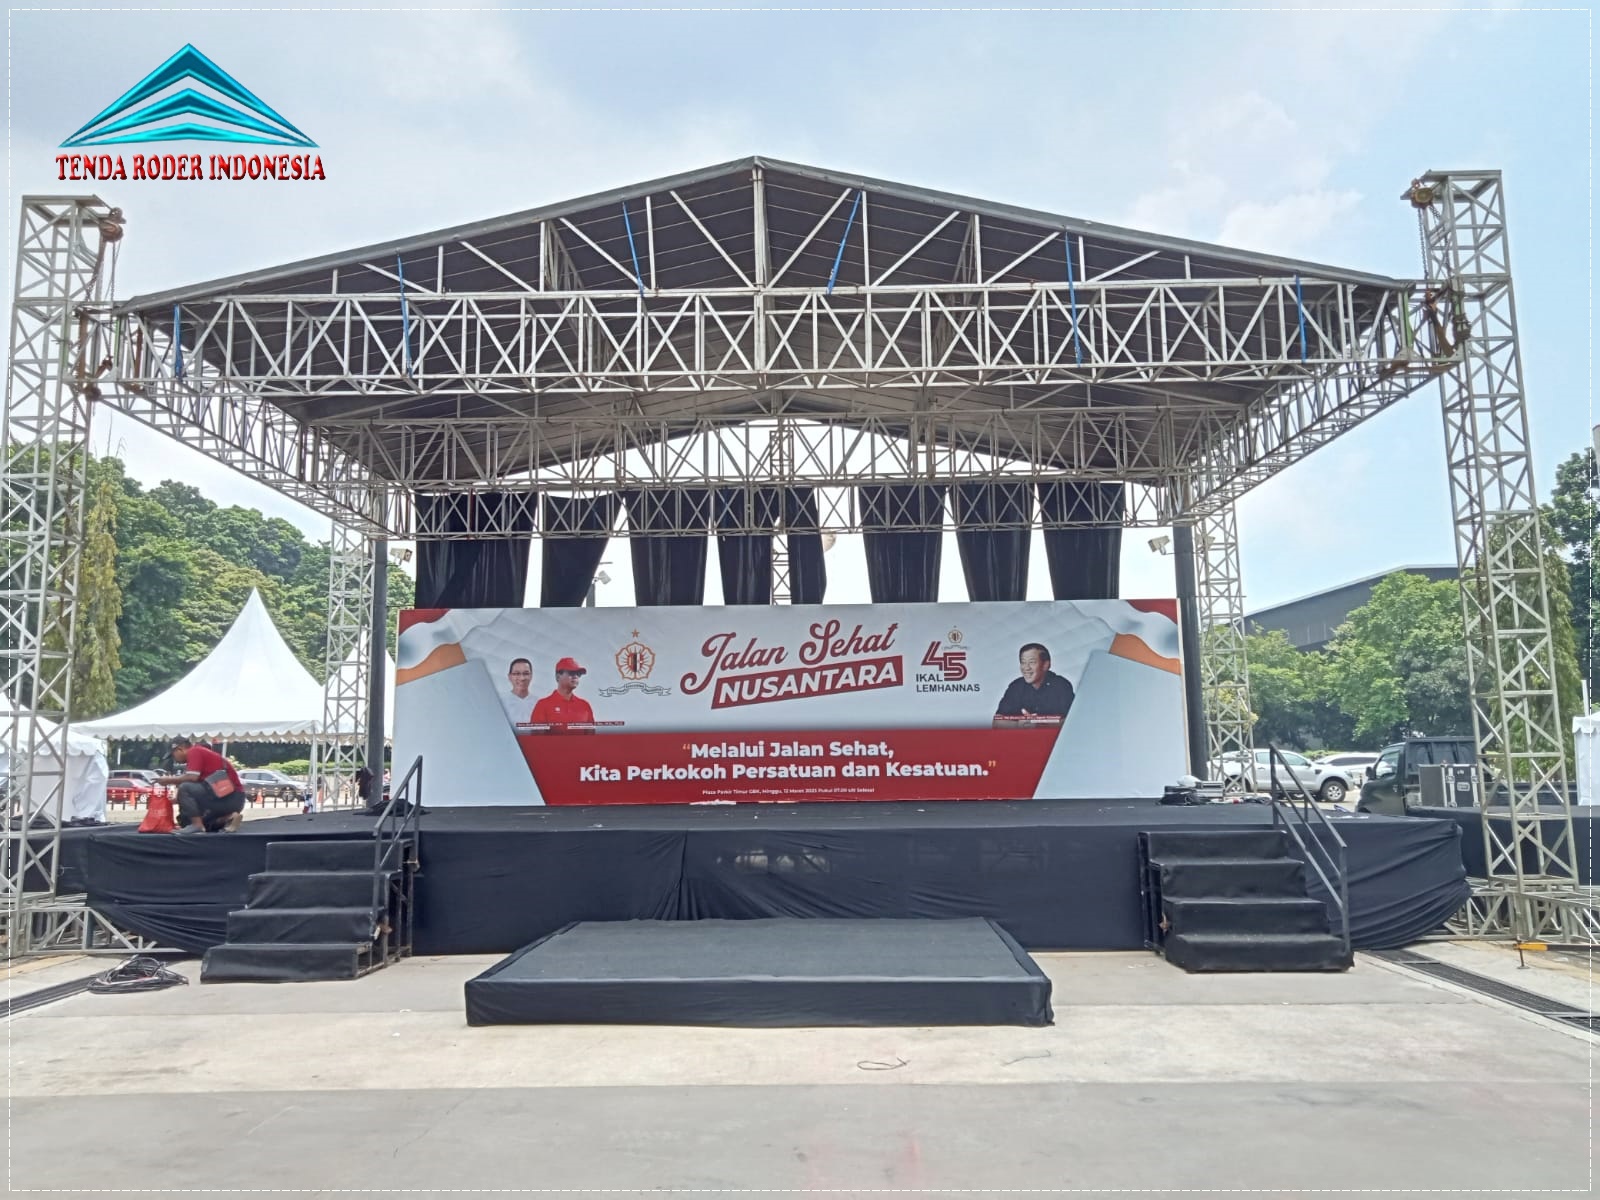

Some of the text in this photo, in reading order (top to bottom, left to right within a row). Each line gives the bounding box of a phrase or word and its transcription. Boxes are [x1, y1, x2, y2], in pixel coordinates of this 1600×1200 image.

[680, 619, 898, 695] Jalan Sehat
[718, 662, 897, 704] NUSANTARA
[916, 673, 943, 682] IKAL
[916, 683, 980, 693] LEMHANNAS
[770, 741, 824, 757] Jalan
[829, 741, 894, 758] Sehat,
[579, 765, 621, 781] Kita
[627, 764, 726, 781] Perkokoh
[732, 763, 836, 779] Persatuan
[842, 762, 880, 777] dan
